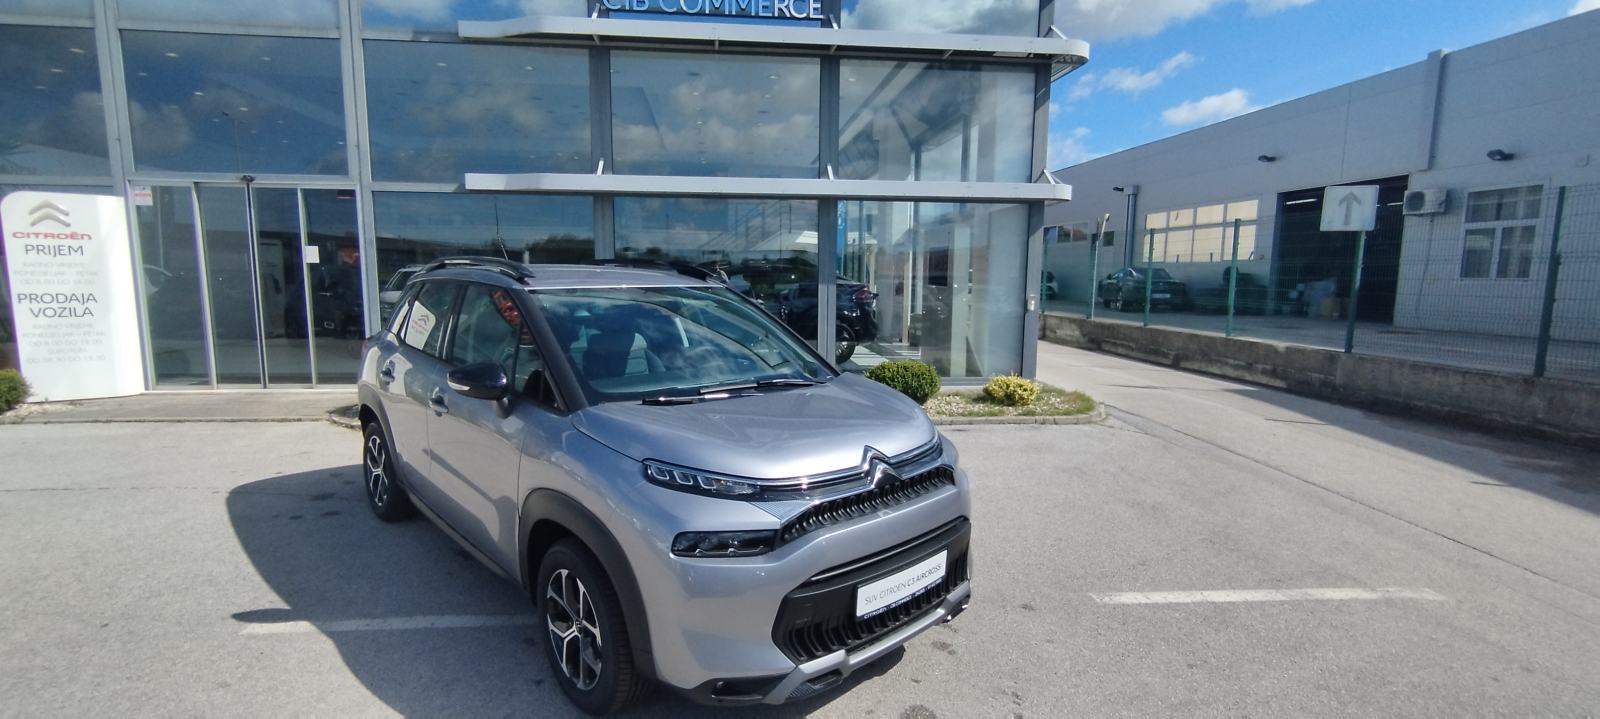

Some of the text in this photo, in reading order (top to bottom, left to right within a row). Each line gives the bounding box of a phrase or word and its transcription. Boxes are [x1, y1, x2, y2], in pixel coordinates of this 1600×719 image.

[660, 0, 824, 19] COMMERCE
[24, 244, 84, 258] PRIJEM
[17, 293, 98, 305] PRODAJA
[29, 307, 95, 318] VOZILA
[864, 594, 879, 605] SUV
